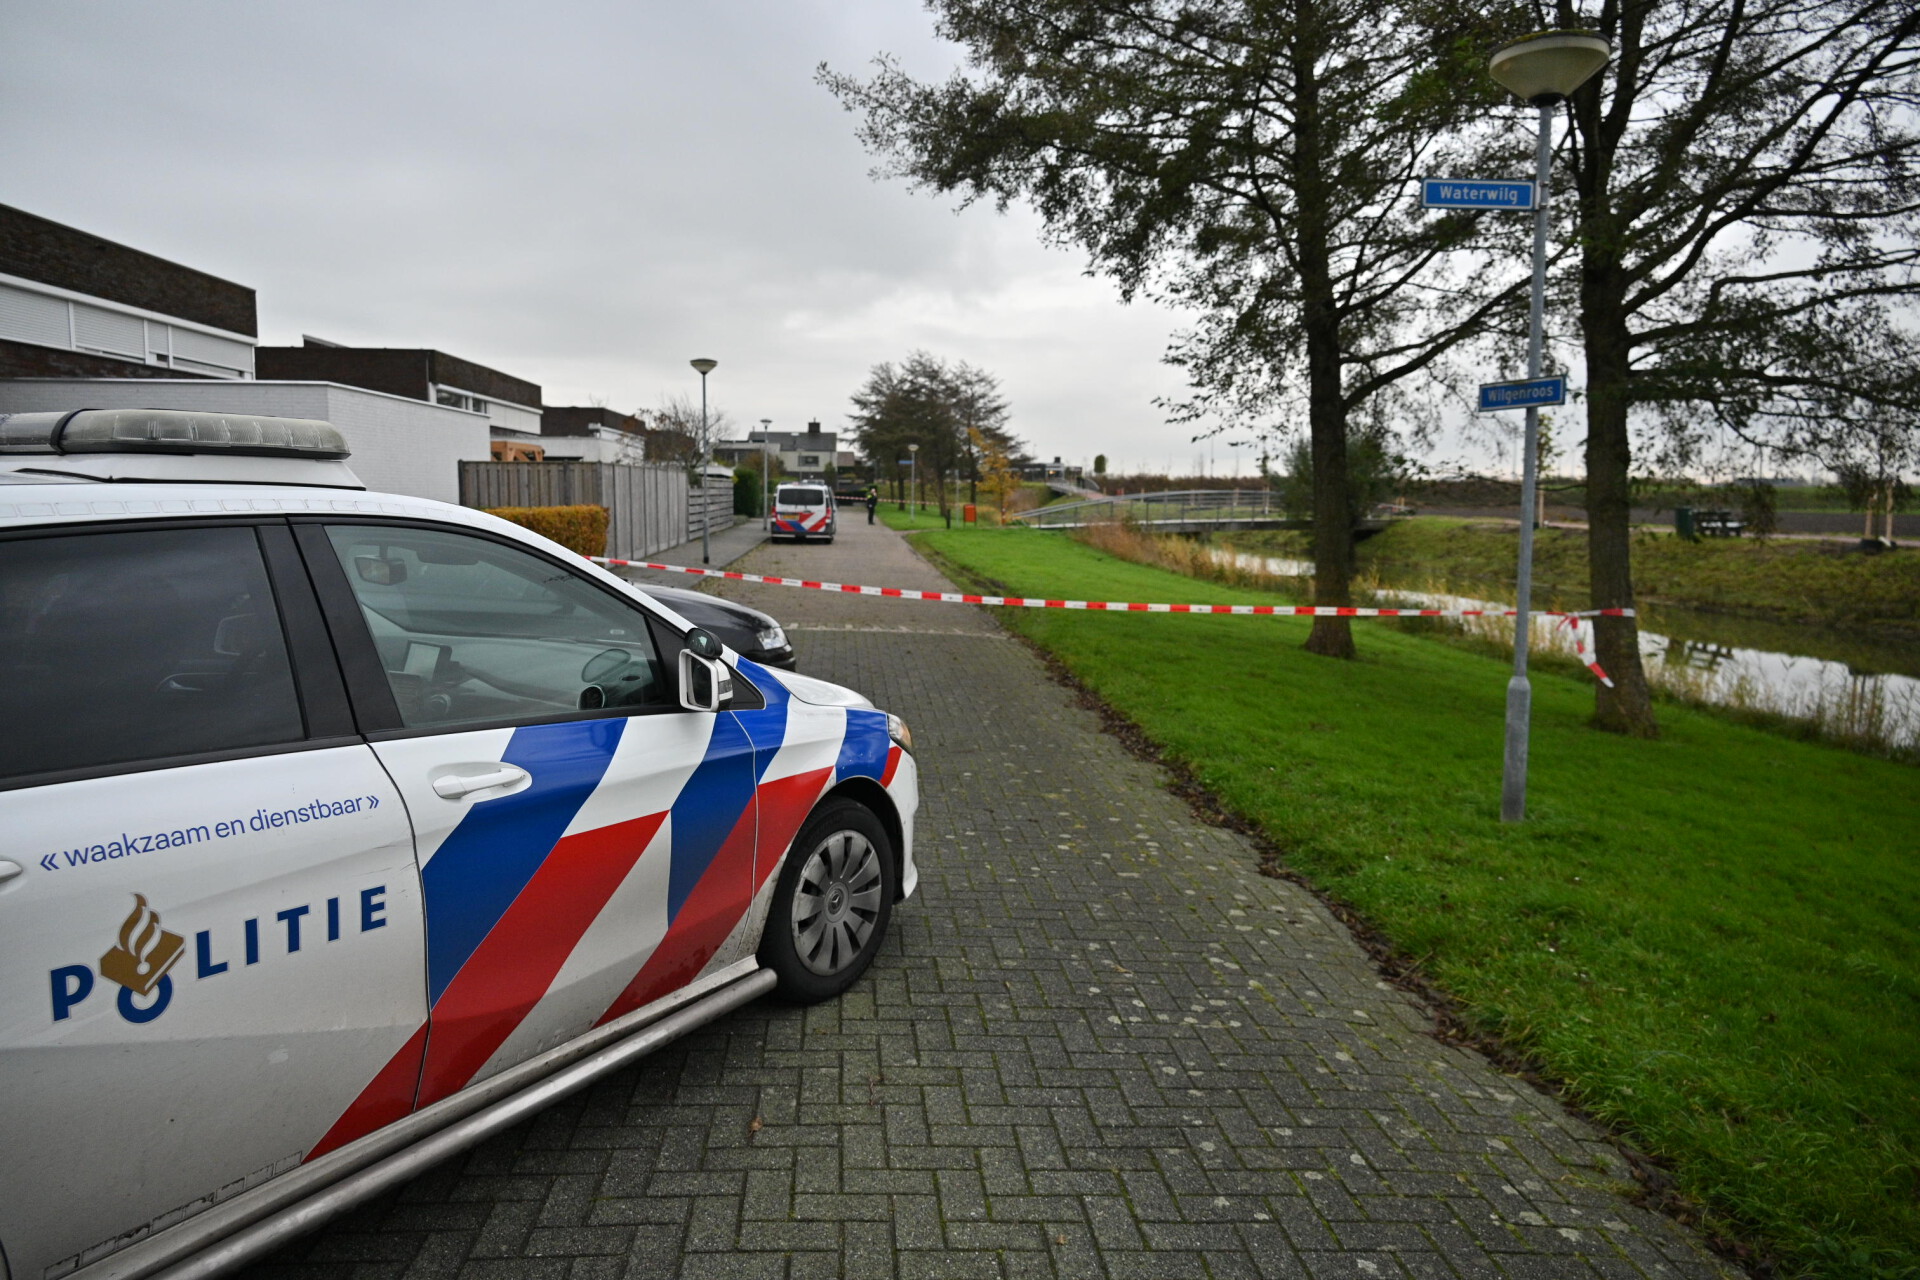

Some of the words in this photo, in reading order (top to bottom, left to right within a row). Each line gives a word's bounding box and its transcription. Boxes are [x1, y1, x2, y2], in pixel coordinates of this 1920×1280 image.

[1440, 186, 1518, 204] Waterwilg
[1487, 386, 1554, 404] Wilgenroos
[64, 824, 210, 867] waakzaam
[215, 819, 246, 838] en
[249, 795, 363, 833] dienstbaar
[50, 885, 387, 1024] POLITIE
